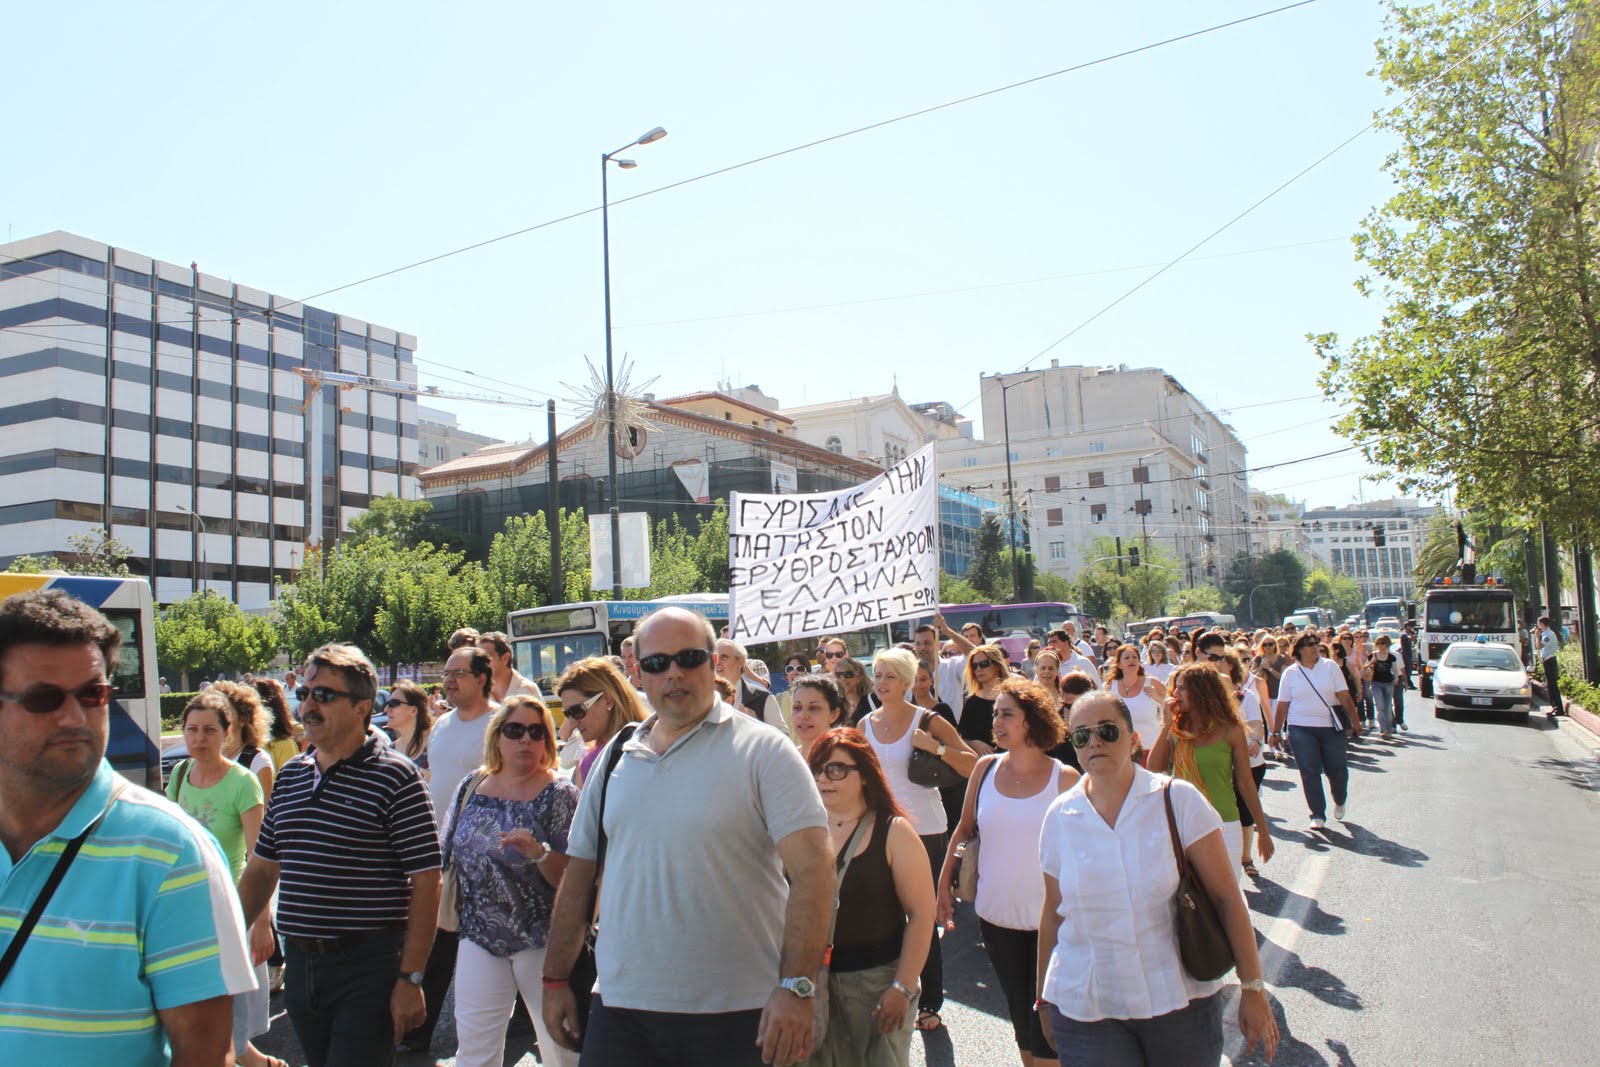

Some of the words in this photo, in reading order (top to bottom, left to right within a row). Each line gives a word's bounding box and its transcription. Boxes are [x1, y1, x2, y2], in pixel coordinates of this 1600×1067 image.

[883, 455, 926, 494] ΤΗΝ
[761, 560, 921, 609] ΕΛΛΗΝΑ
[731, 598, 891, 639] ΑΝΤΕΔΡΑΣΕ
